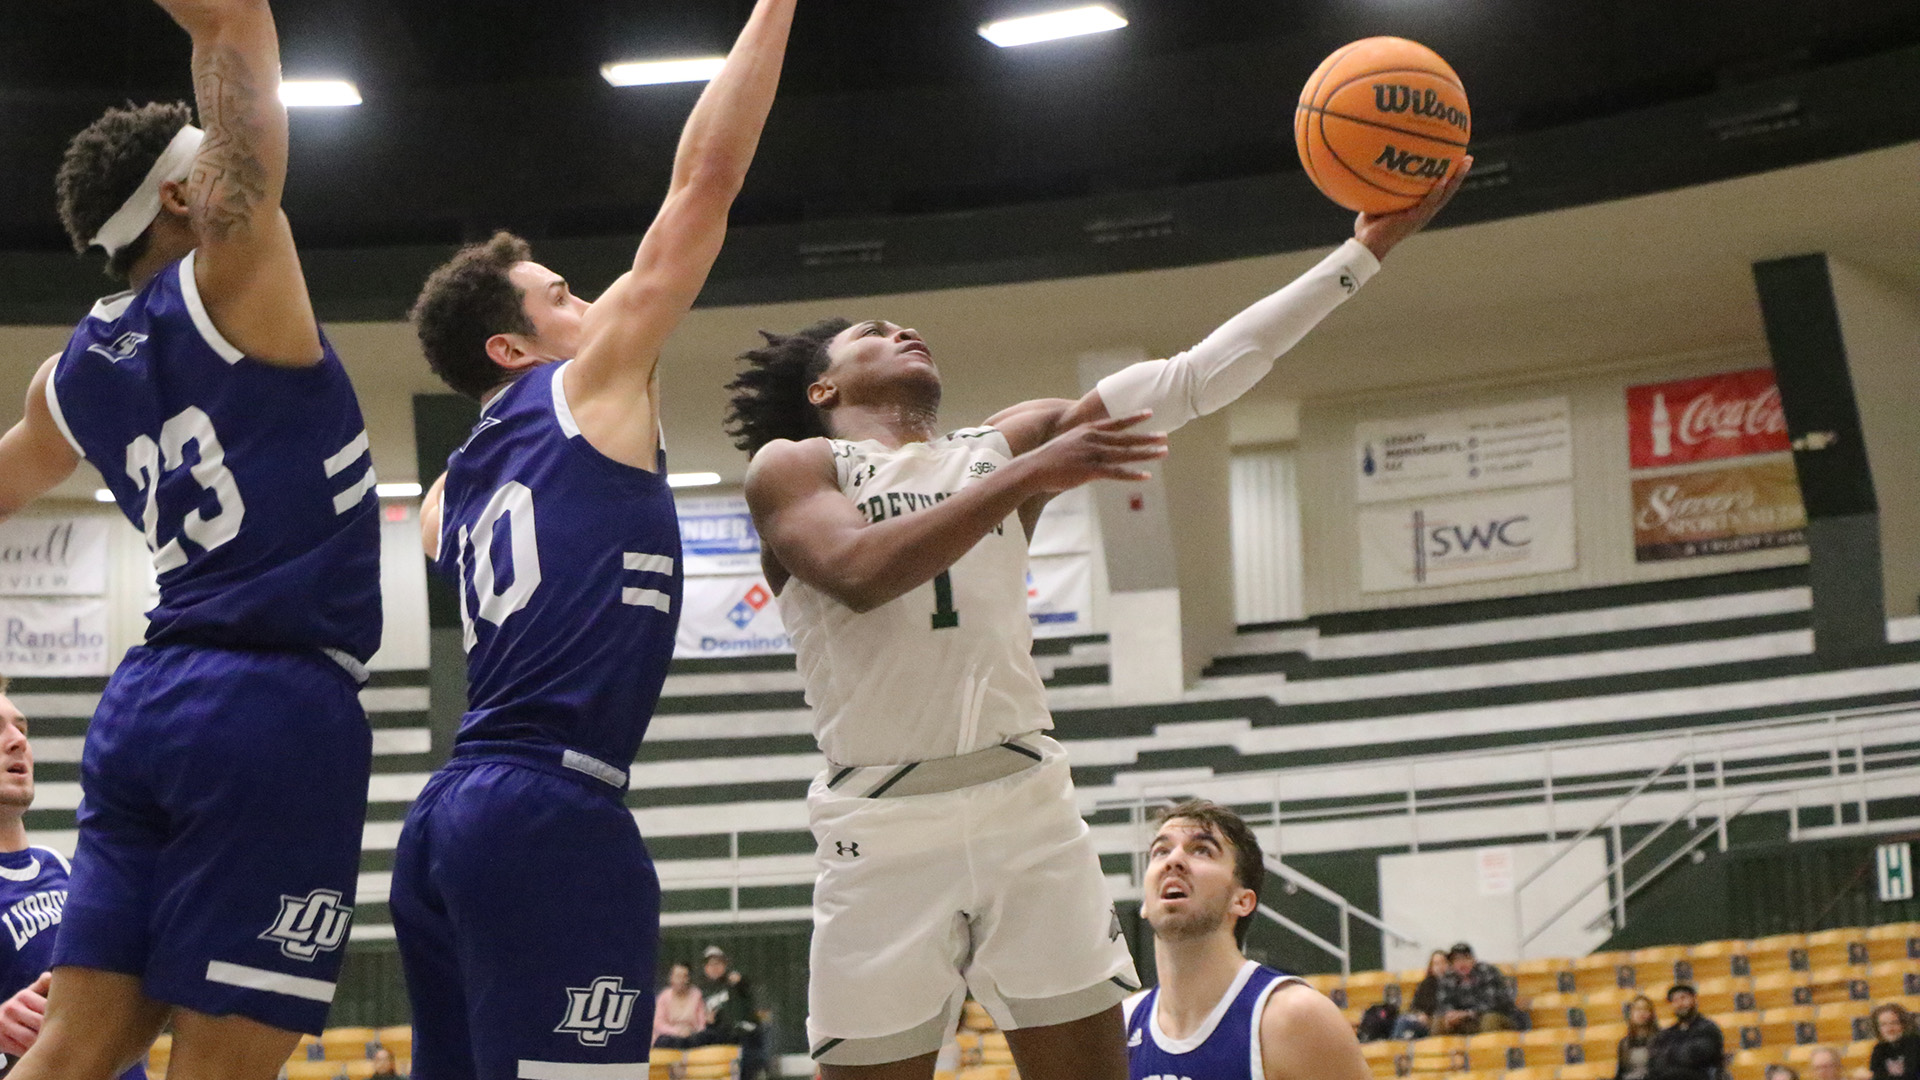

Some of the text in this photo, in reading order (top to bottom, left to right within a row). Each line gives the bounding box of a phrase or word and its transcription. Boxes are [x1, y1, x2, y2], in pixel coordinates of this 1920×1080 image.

[1373, 84, 1467, 131] Wilson
[1373, 145, 1451, 179] NCAA
[125, 405, 246, 575] 23
[1432, 515, 1531, 557] SWC
[457, 480, 542, 654] 10
[6, 617, 103, 648] Rancho
[1886, 847, 1904, 895] H
[261, 890, 352, 960] LCU
[557, 978, 637, 1043] LCU
